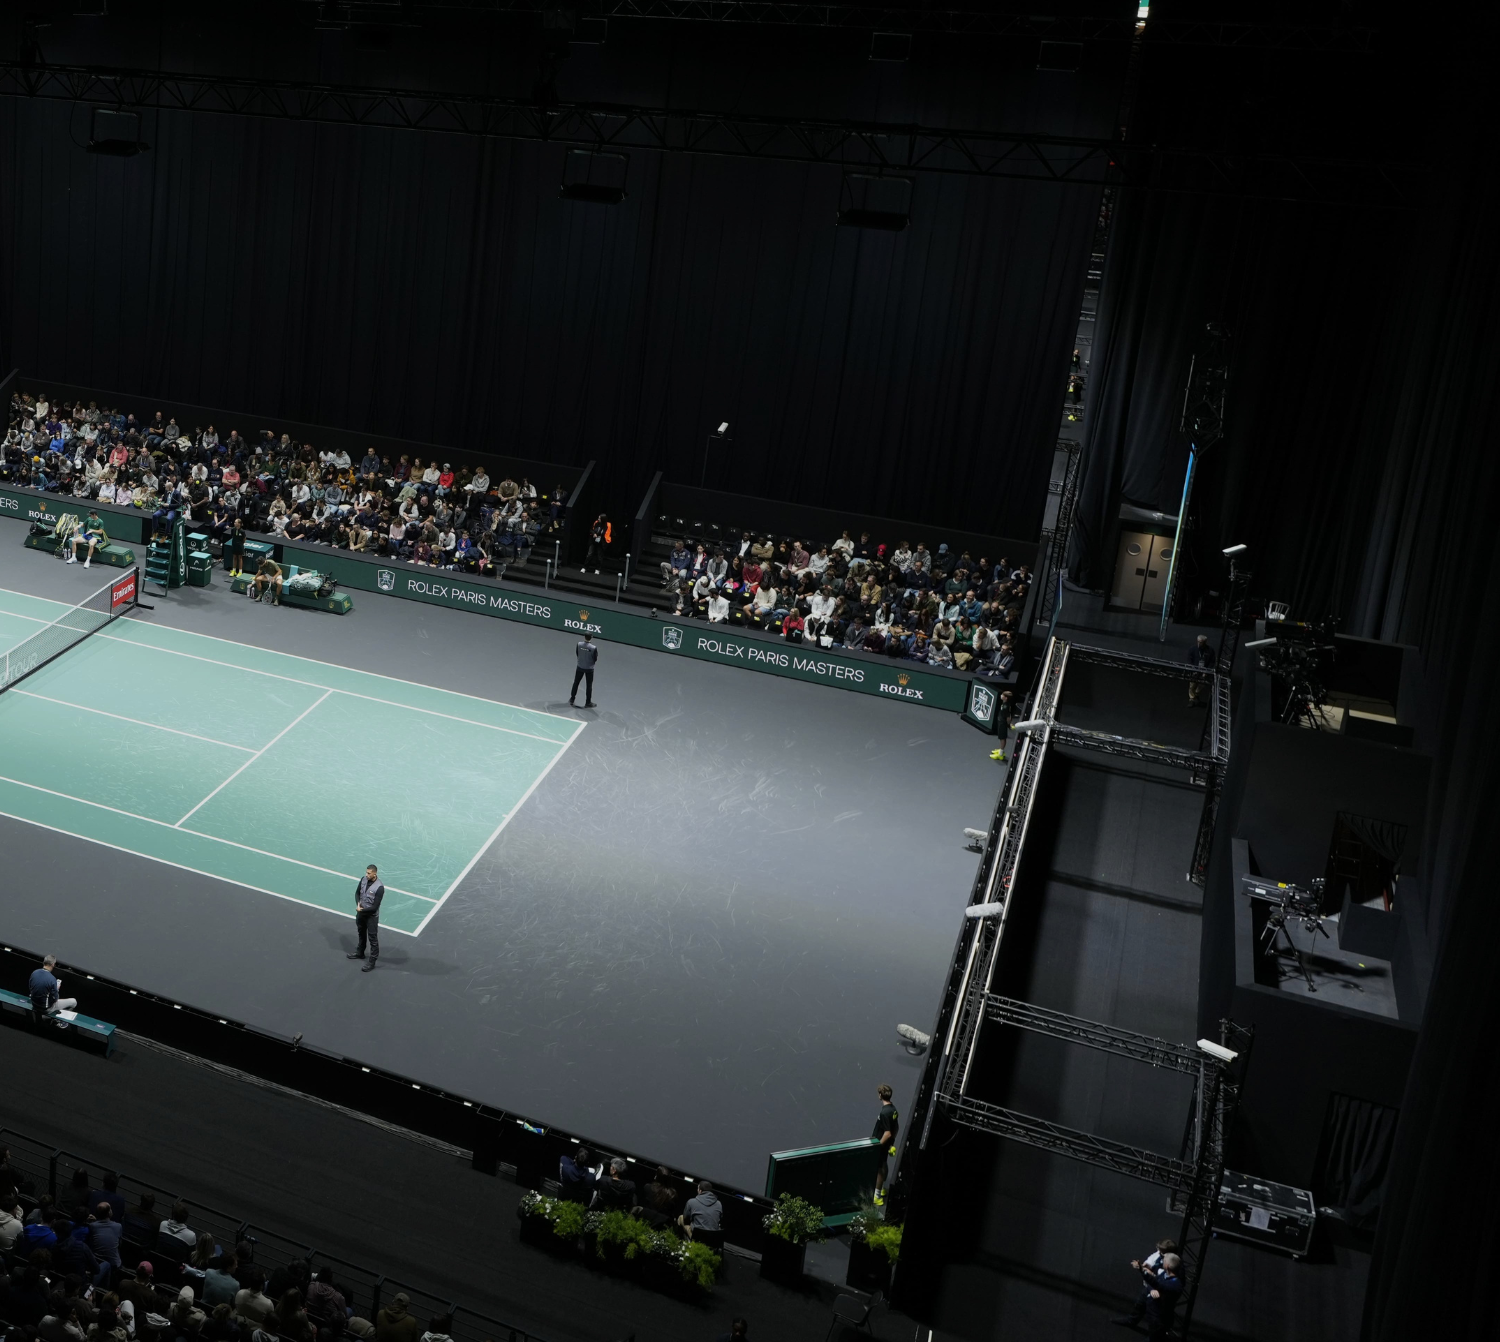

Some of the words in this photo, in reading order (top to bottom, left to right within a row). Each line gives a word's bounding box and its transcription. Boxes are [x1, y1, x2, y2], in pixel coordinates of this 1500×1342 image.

[28, 510, 56, 522] ROLEX
[114, 583, 134, 601] Emirates
[408, 580, 448, 598] ROLEX
[452, 588, 486, 605] PARIS
[490, 596, 551, 618] MASTERS
[564, 619, 601, 634] ROLEX
[9, 652, 38, 681] TOUR
[697, 638, 744, 658] ROLEX
[748, 648, 789, 666] PARIS
[793, 657, 865, 682] MASTERS
[879, 683, 923, 699] ROLEX
